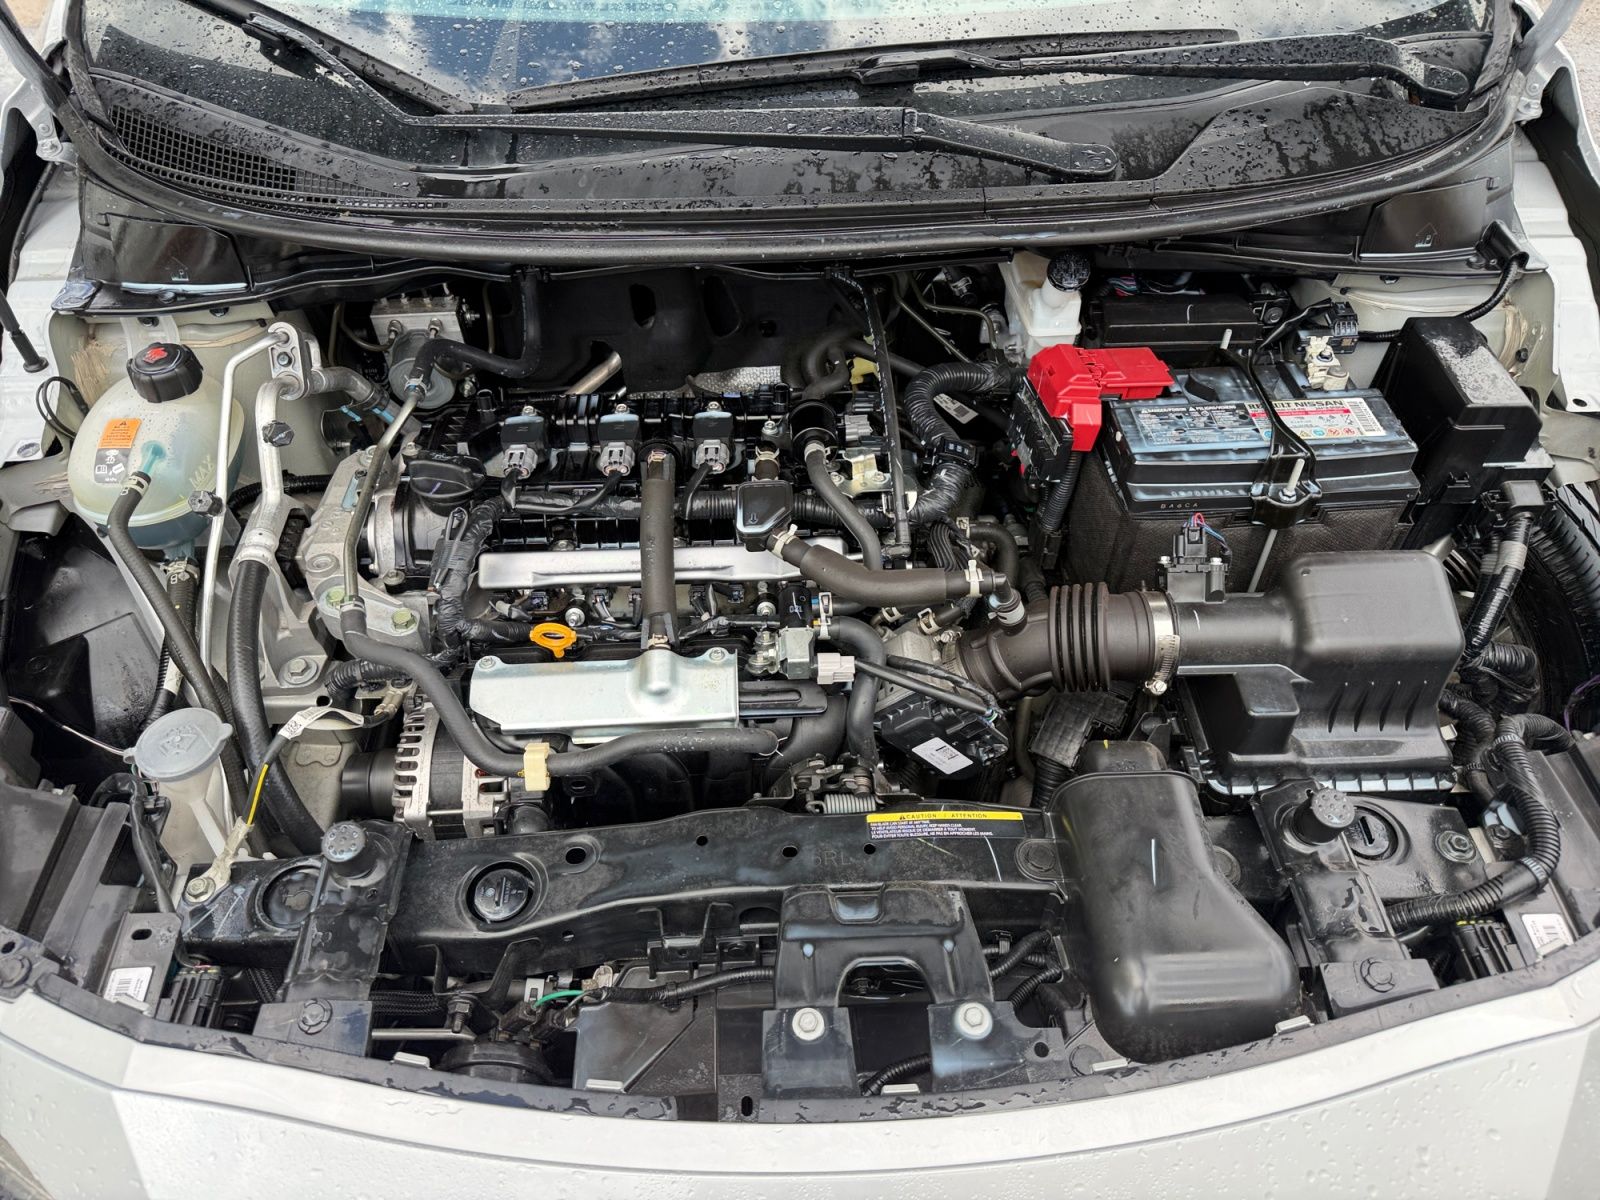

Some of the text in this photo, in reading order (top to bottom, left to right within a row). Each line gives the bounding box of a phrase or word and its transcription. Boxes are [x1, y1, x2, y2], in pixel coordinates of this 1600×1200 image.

[1247, 399, 1345, 409] REULT NISSAN
[189, 454, 214, 489] MAX
